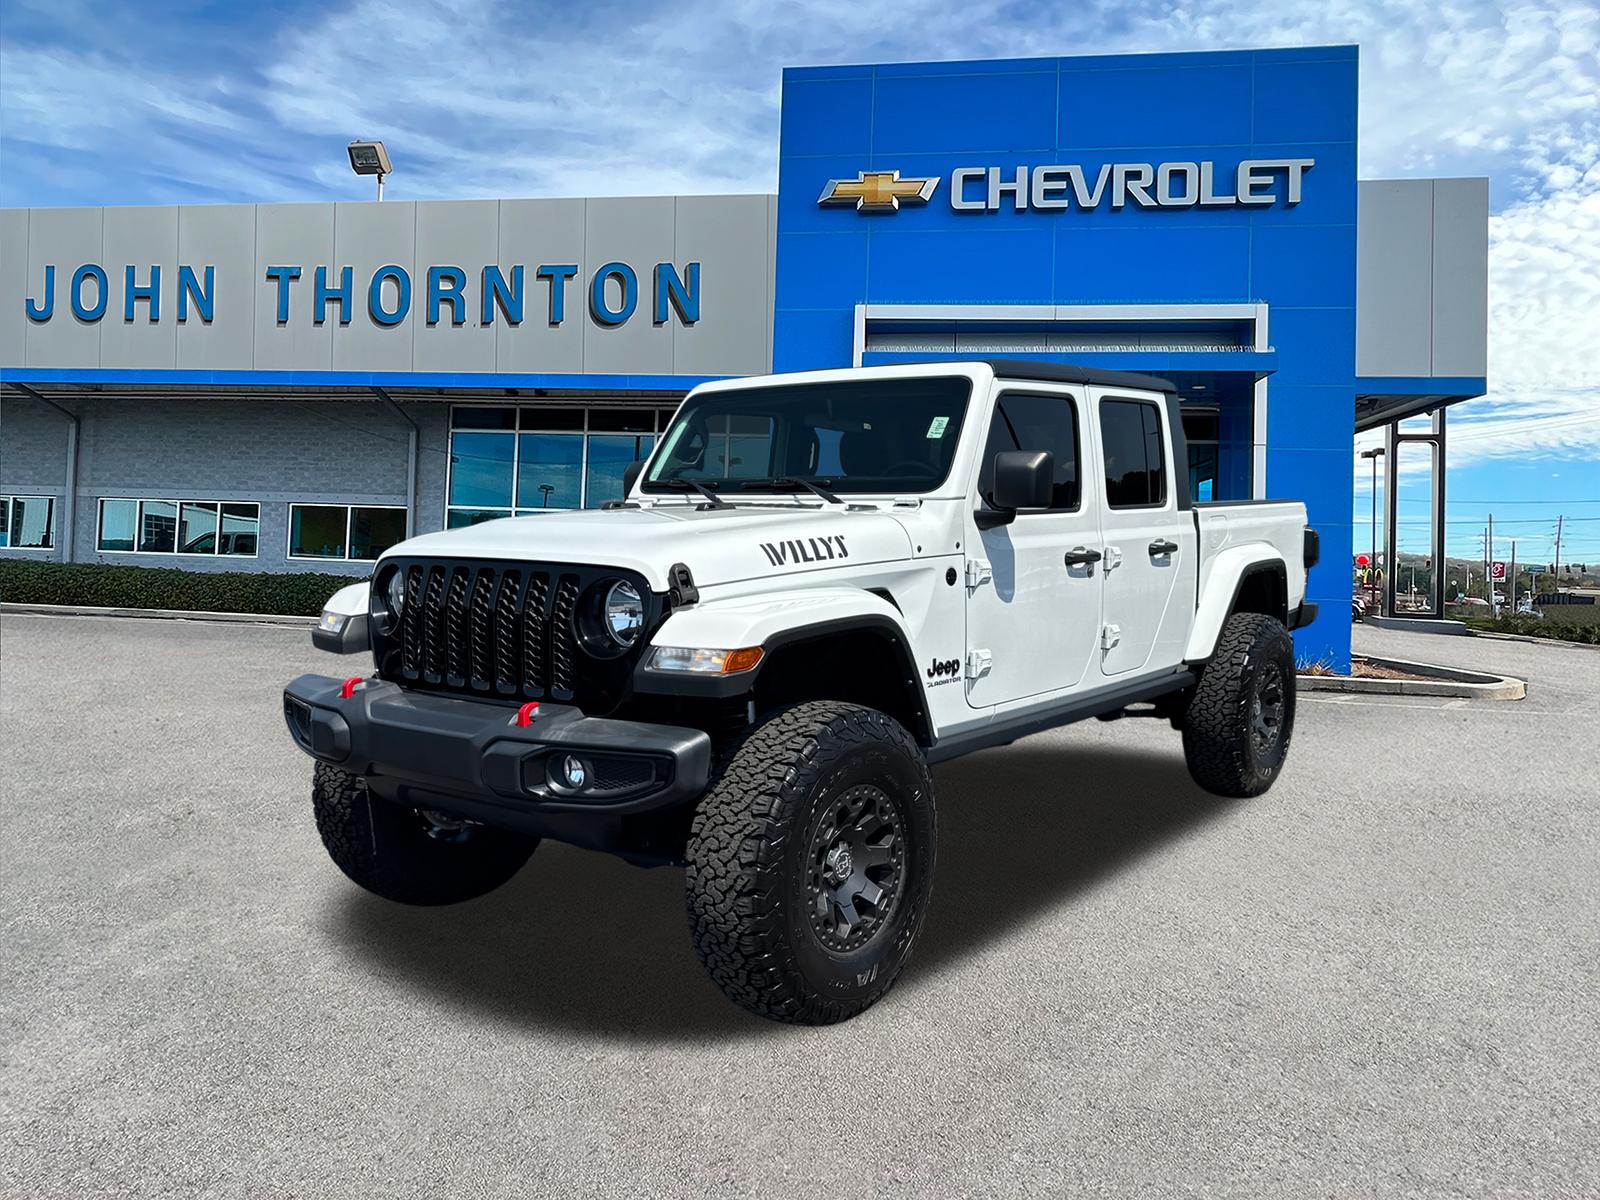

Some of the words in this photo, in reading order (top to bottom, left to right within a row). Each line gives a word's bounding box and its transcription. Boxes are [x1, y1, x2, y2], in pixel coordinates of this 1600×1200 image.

[950, 158, 1315, 211] CHEVROLET
[25, 263, 216, 324] JOHN
[265, 261, 702, 328] THORNTON
[759, 535, 848, 567] WILLYS
[927, 658, 960, 677] Jeep
